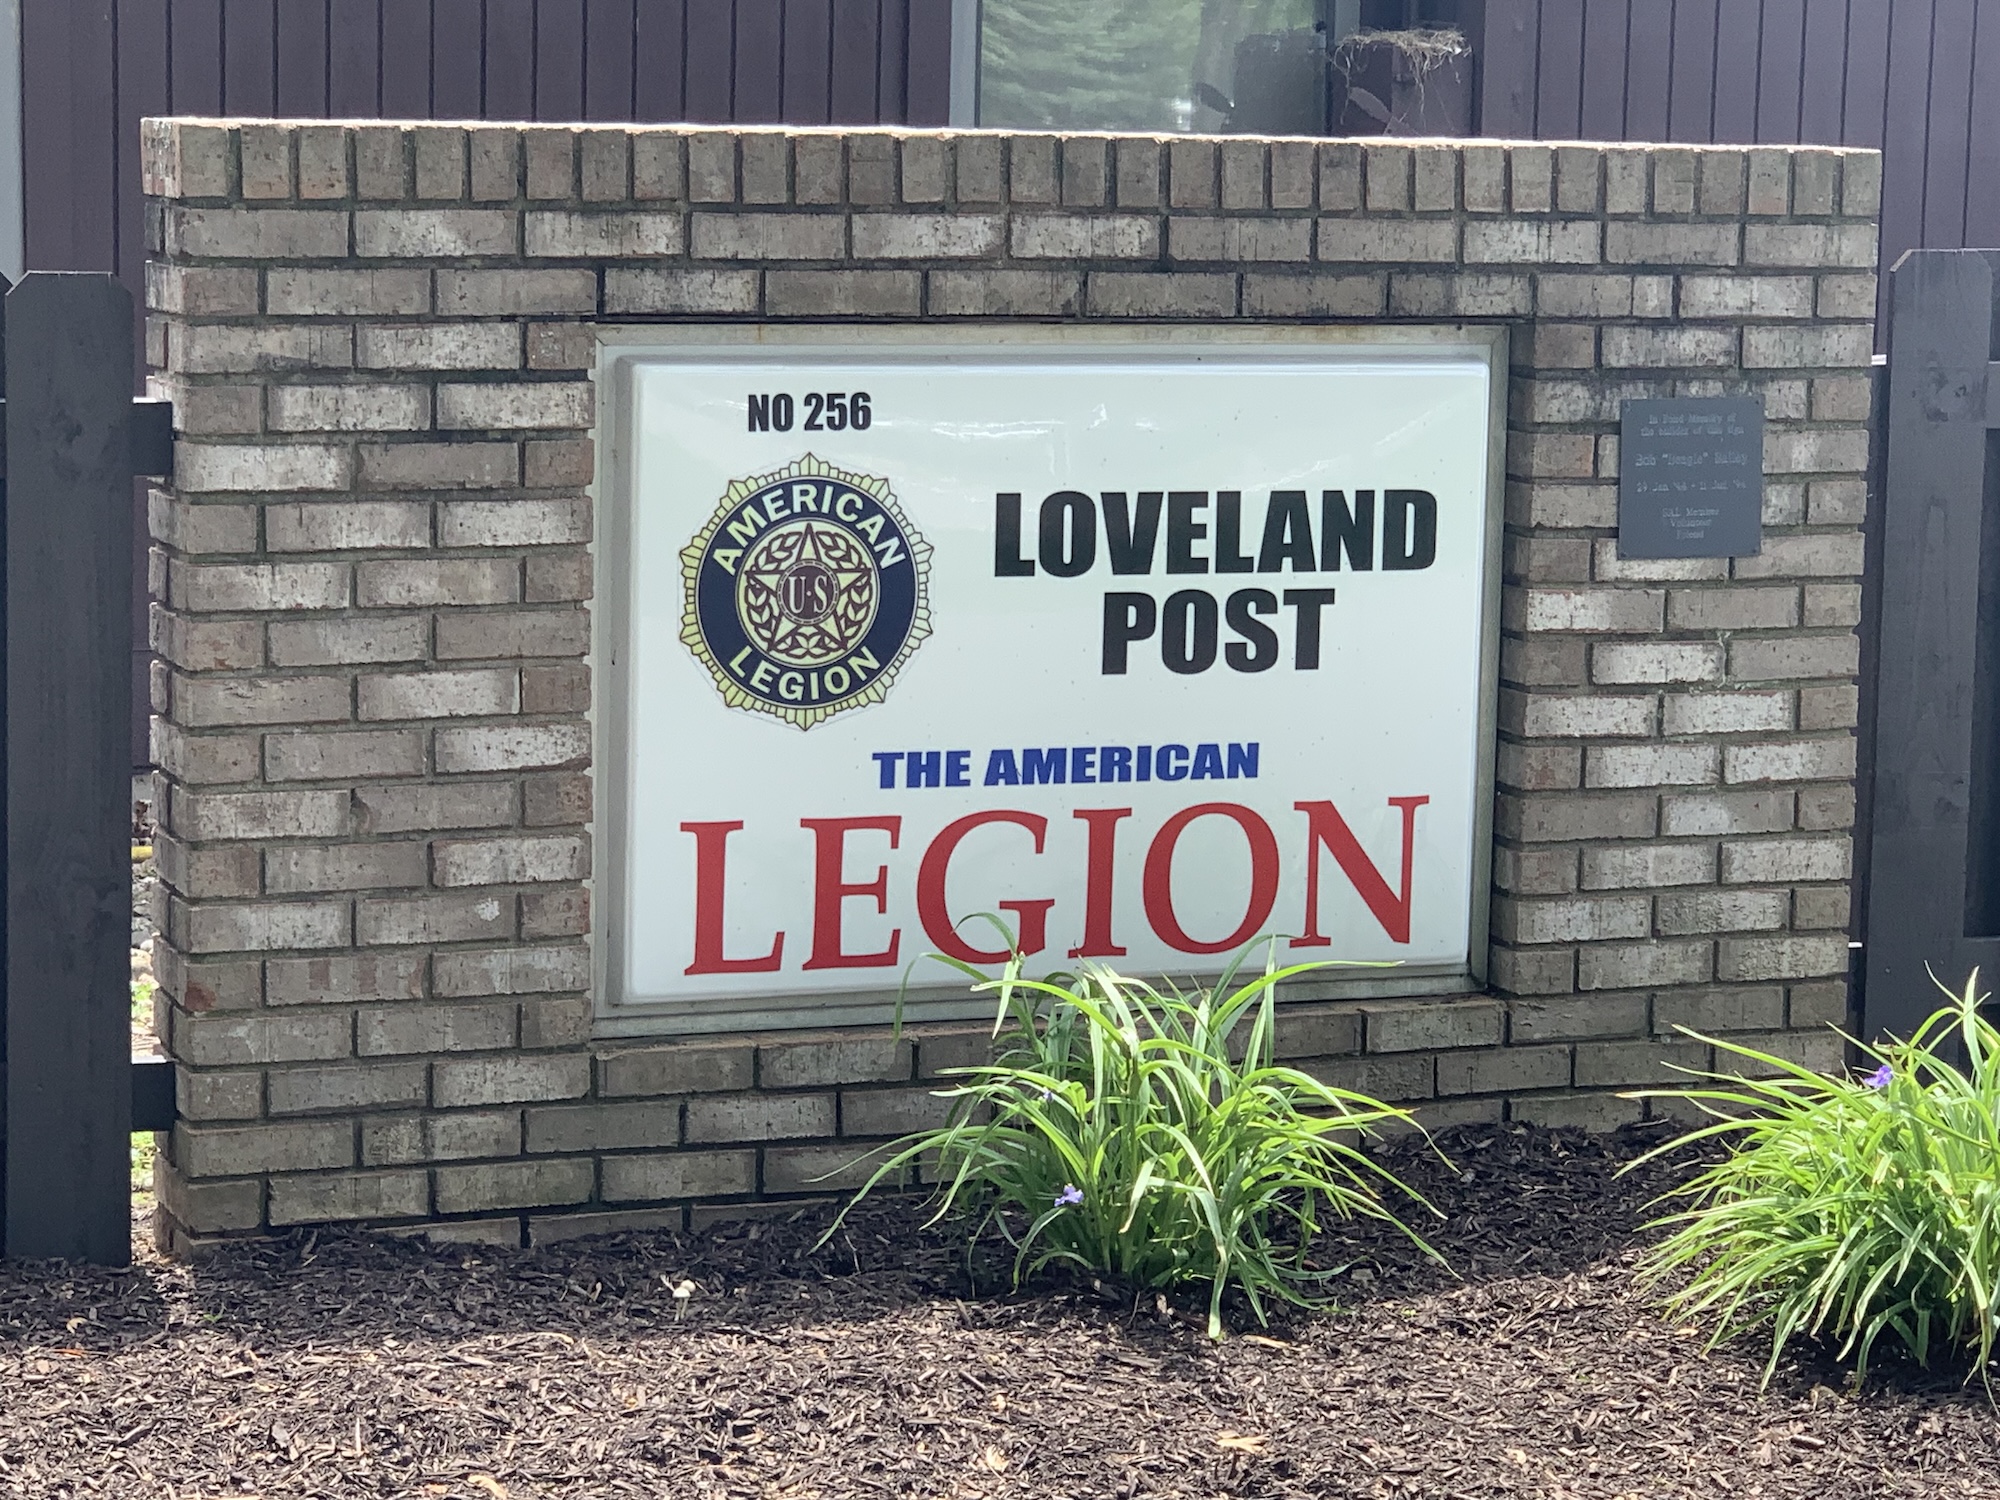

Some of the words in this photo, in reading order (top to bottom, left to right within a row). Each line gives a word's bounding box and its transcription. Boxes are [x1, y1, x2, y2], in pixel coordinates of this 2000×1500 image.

[748, 394, 794, 432] NO
[803, 392, 872, 431] 256
[712, 484, 906, 577] AMERICAN
[994, 489, 1437, 578] LOVELAND
[729, 645, 881, 701] LEGION
[1101, 588, 1335, 675] POST
[872, 751, 970, 789] THE
[983, 742, 1260, 787] AMERICAN
[680, 795, 1429, 976] LEGION
